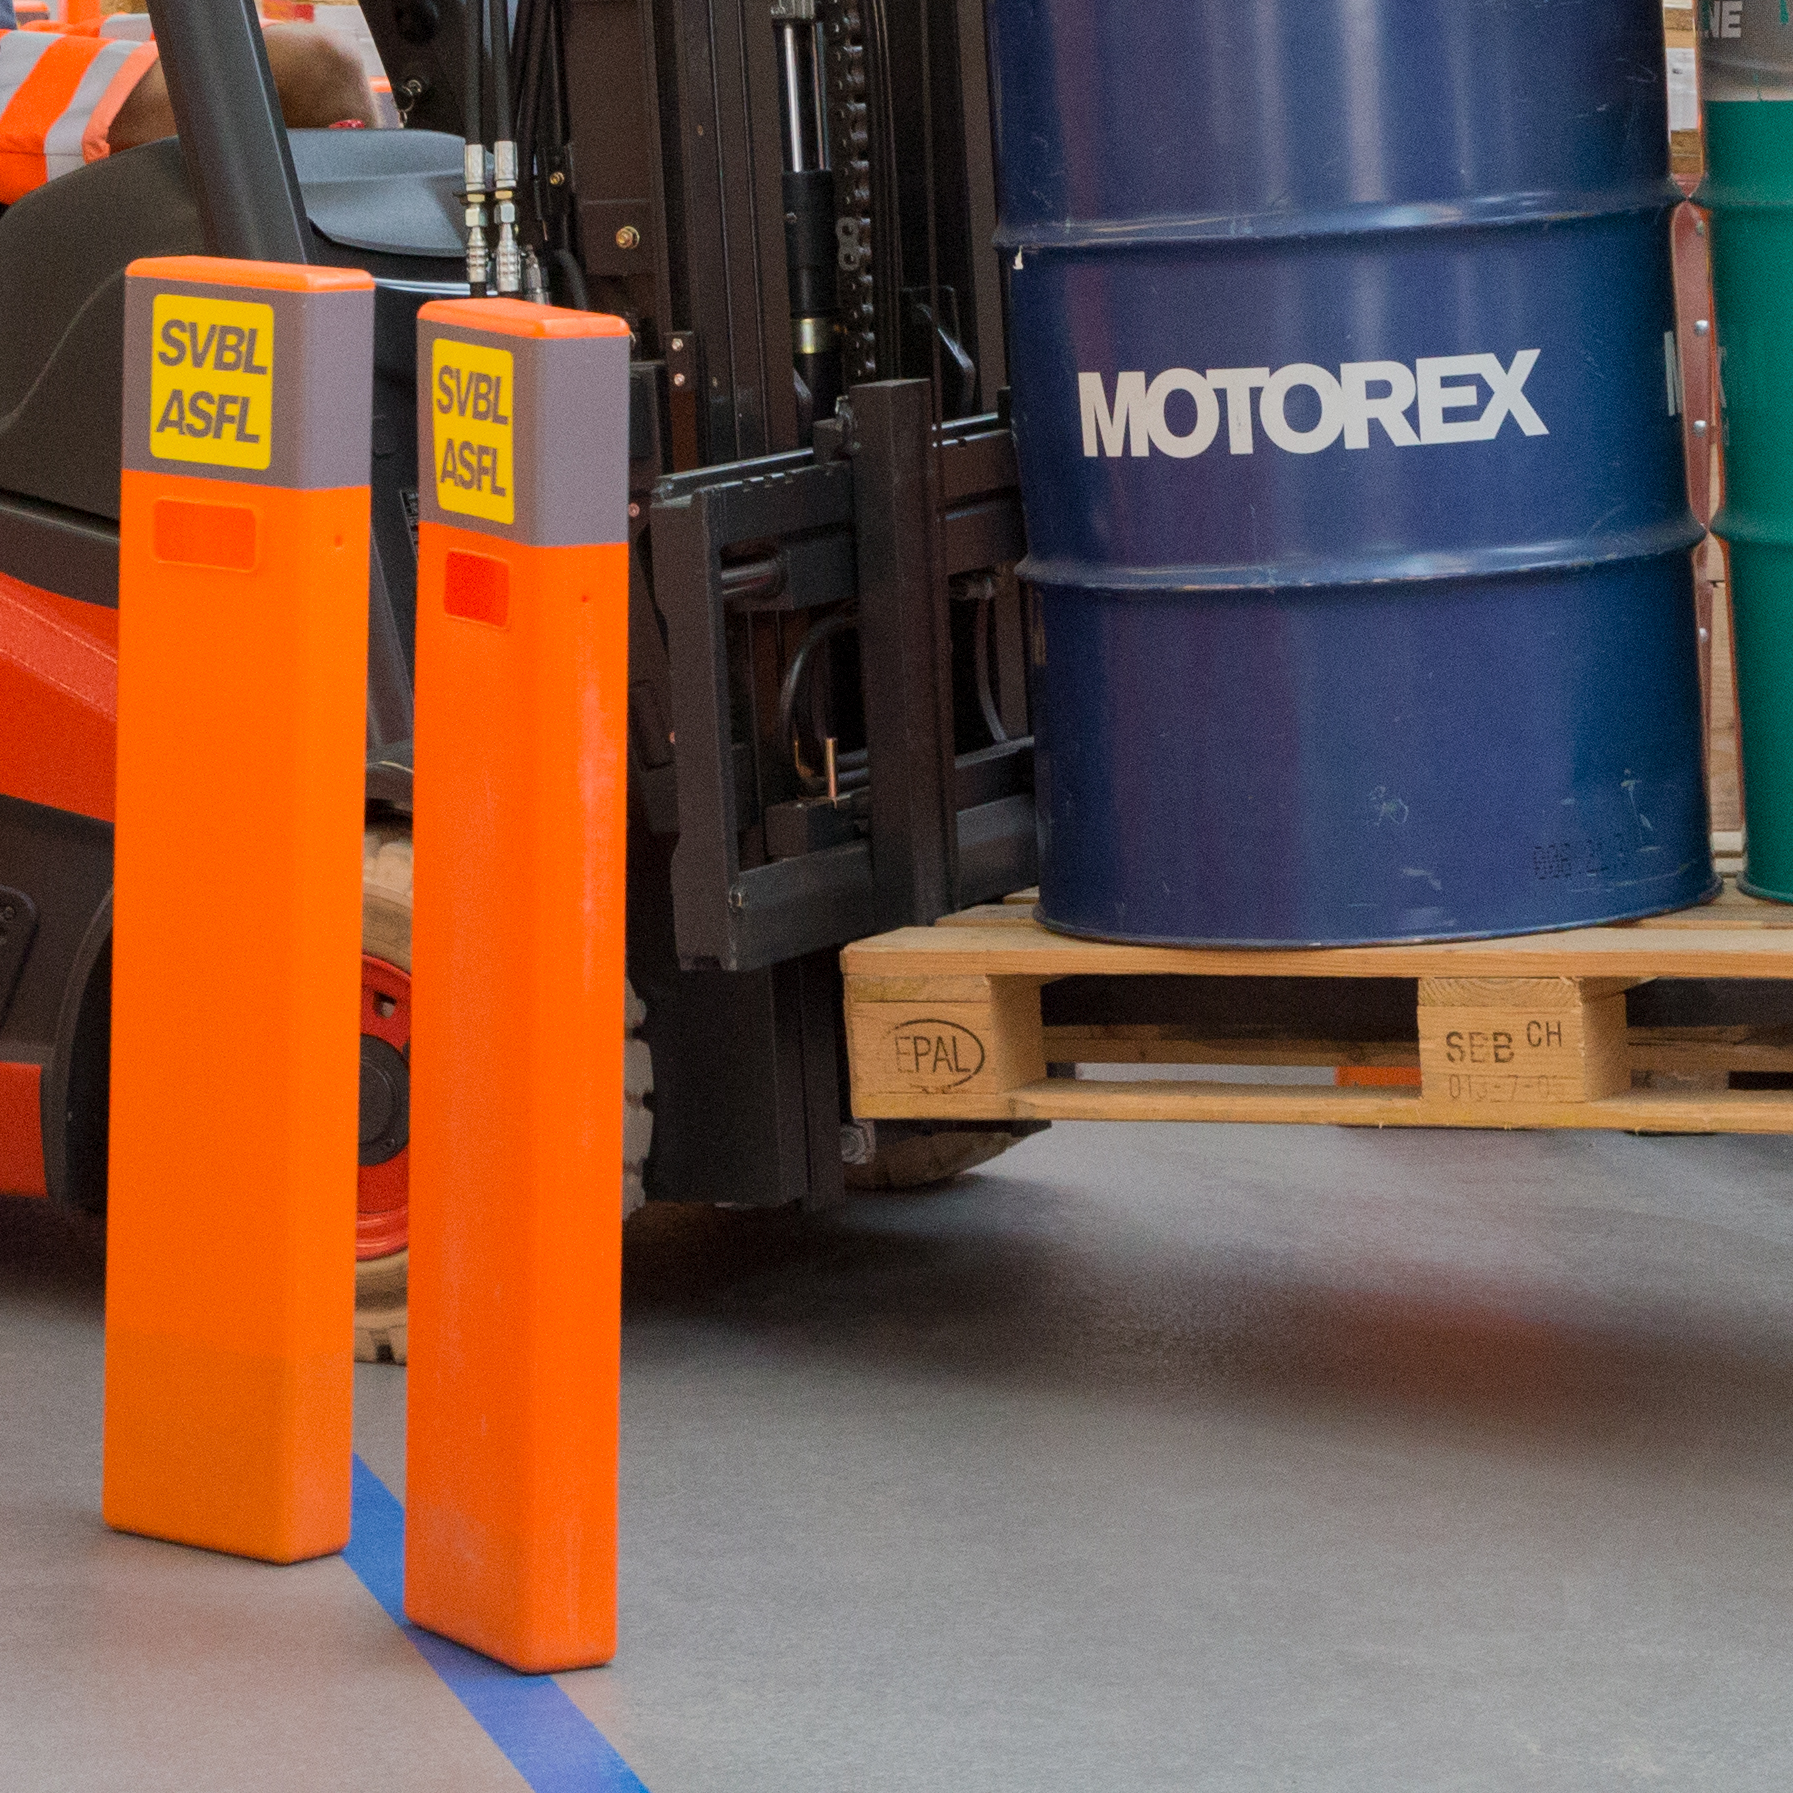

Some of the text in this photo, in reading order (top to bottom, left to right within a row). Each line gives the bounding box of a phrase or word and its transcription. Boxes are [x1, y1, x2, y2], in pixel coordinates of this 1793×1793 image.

[157, 318, 268, 377] SVBL
[155, 390, 261, 444] ASFL
[437, 365, 509, 425] SVBL
[1077, 349, 1550, 459] MOTOREX
[440, 439, 506, 496] ASFL
[894, 1035, 972, 1074] EPAL
[1526, 1020, 1563, 1048] CH
